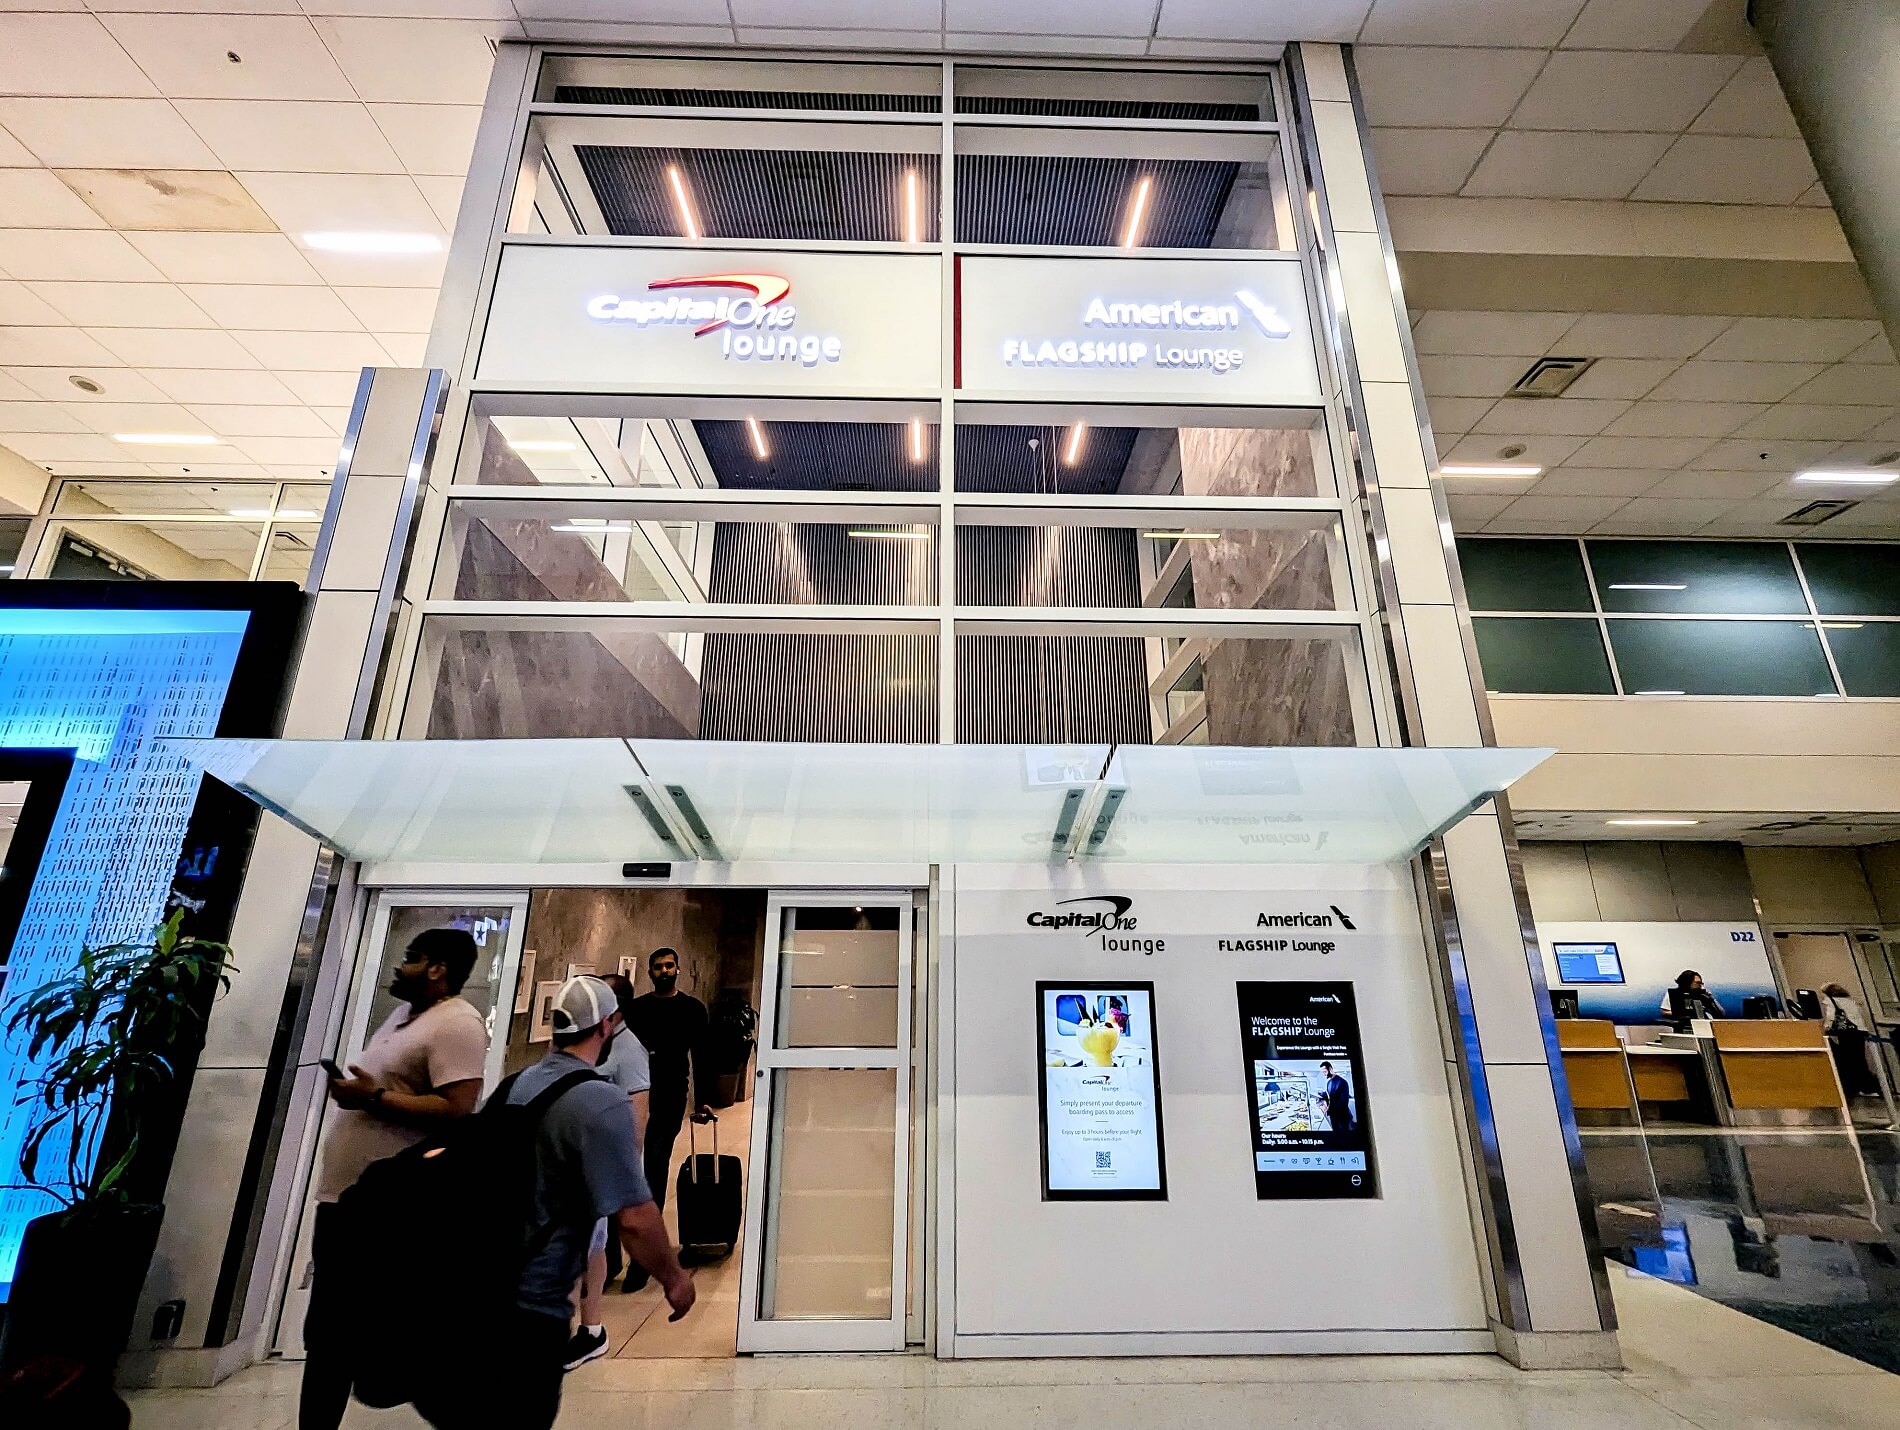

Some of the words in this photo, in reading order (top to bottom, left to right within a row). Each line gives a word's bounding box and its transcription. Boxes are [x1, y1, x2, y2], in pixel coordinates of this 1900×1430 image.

[1084, 298, 1239, 330] American
[722, 328, 842, 367] lounge
[1003, 340, 1149, 368] FLAGSHIP
[1155, 342, 1245, 375] Lounge
[1256, 911, 1333, 928] American
[1730, 931, 1756, 942] D22
[1102, 934, 1166, 956] lounge
[1218, 939, 1288, 952] FLAGSHIP
[1292, 939, 1336, 955] Lounge
[1251, 1016, 1291, 1026] Welcome
[1292, 1017, 1302, 1026] to
[1303, 1016, 1318, 1026] the
[1304, 1026, 1335, 1038] Lounge
[1060, 1099, 1078, 1107] Simply
